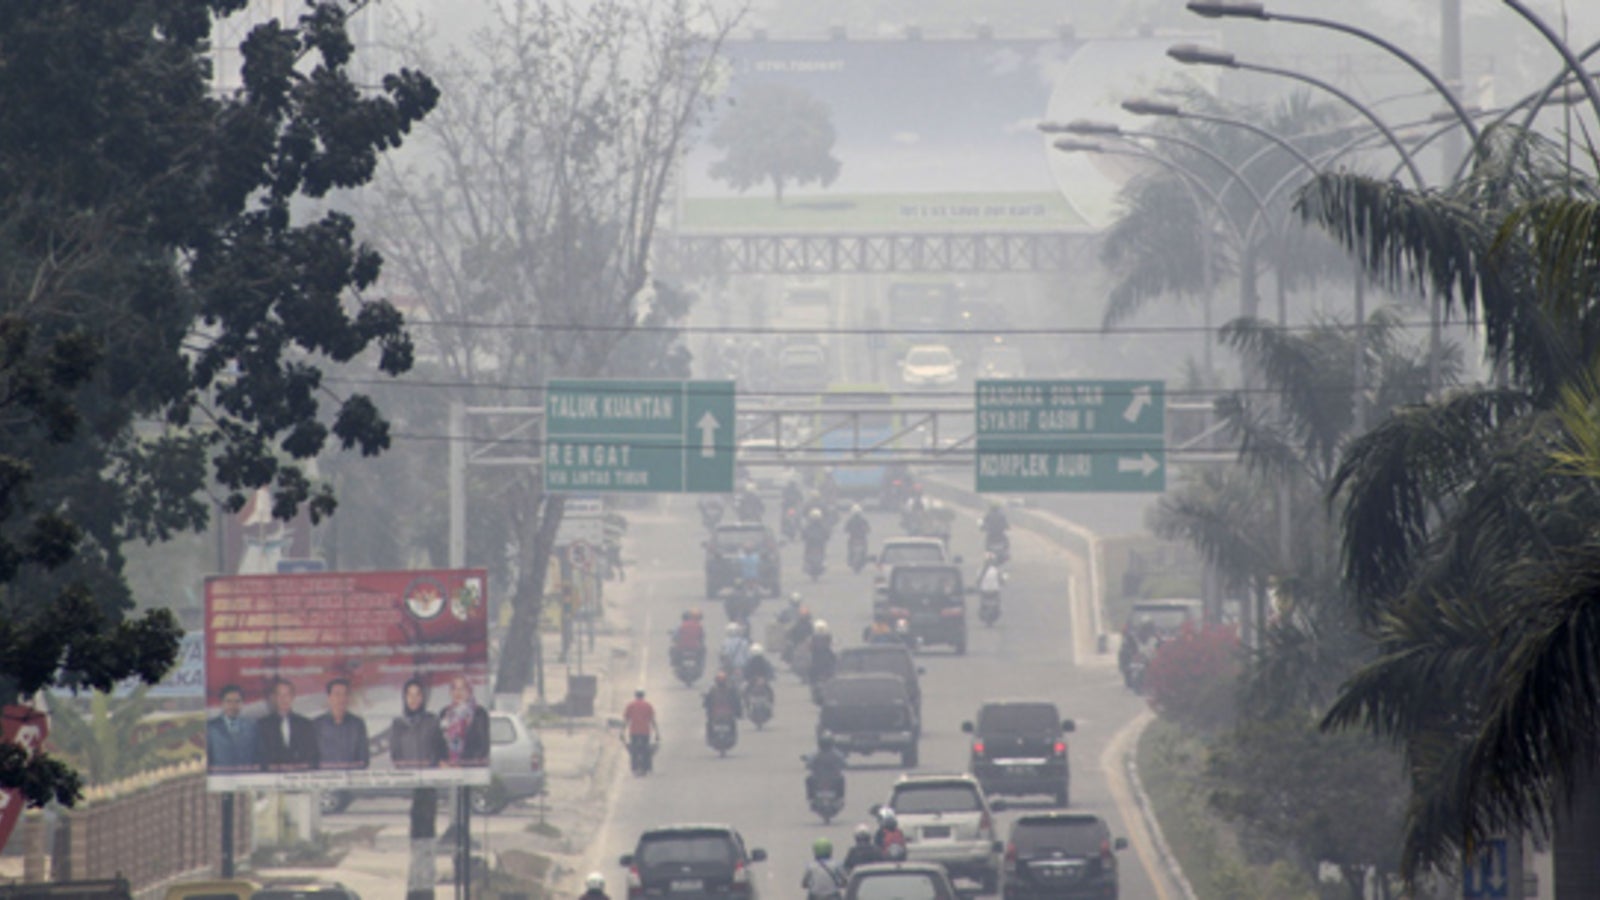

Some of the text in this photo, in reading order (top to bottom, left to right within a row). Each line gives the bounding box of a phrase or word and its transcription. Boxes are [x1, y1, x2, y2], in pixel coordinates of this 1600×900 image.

[550, 394, 674, 420] TALUK KUANTAN
[980, 409, 1031, 431] SYARIF
[548, 443, 631, 467] RENGAT
[979, 453, 1092, 477] KOMPLEK AURI
